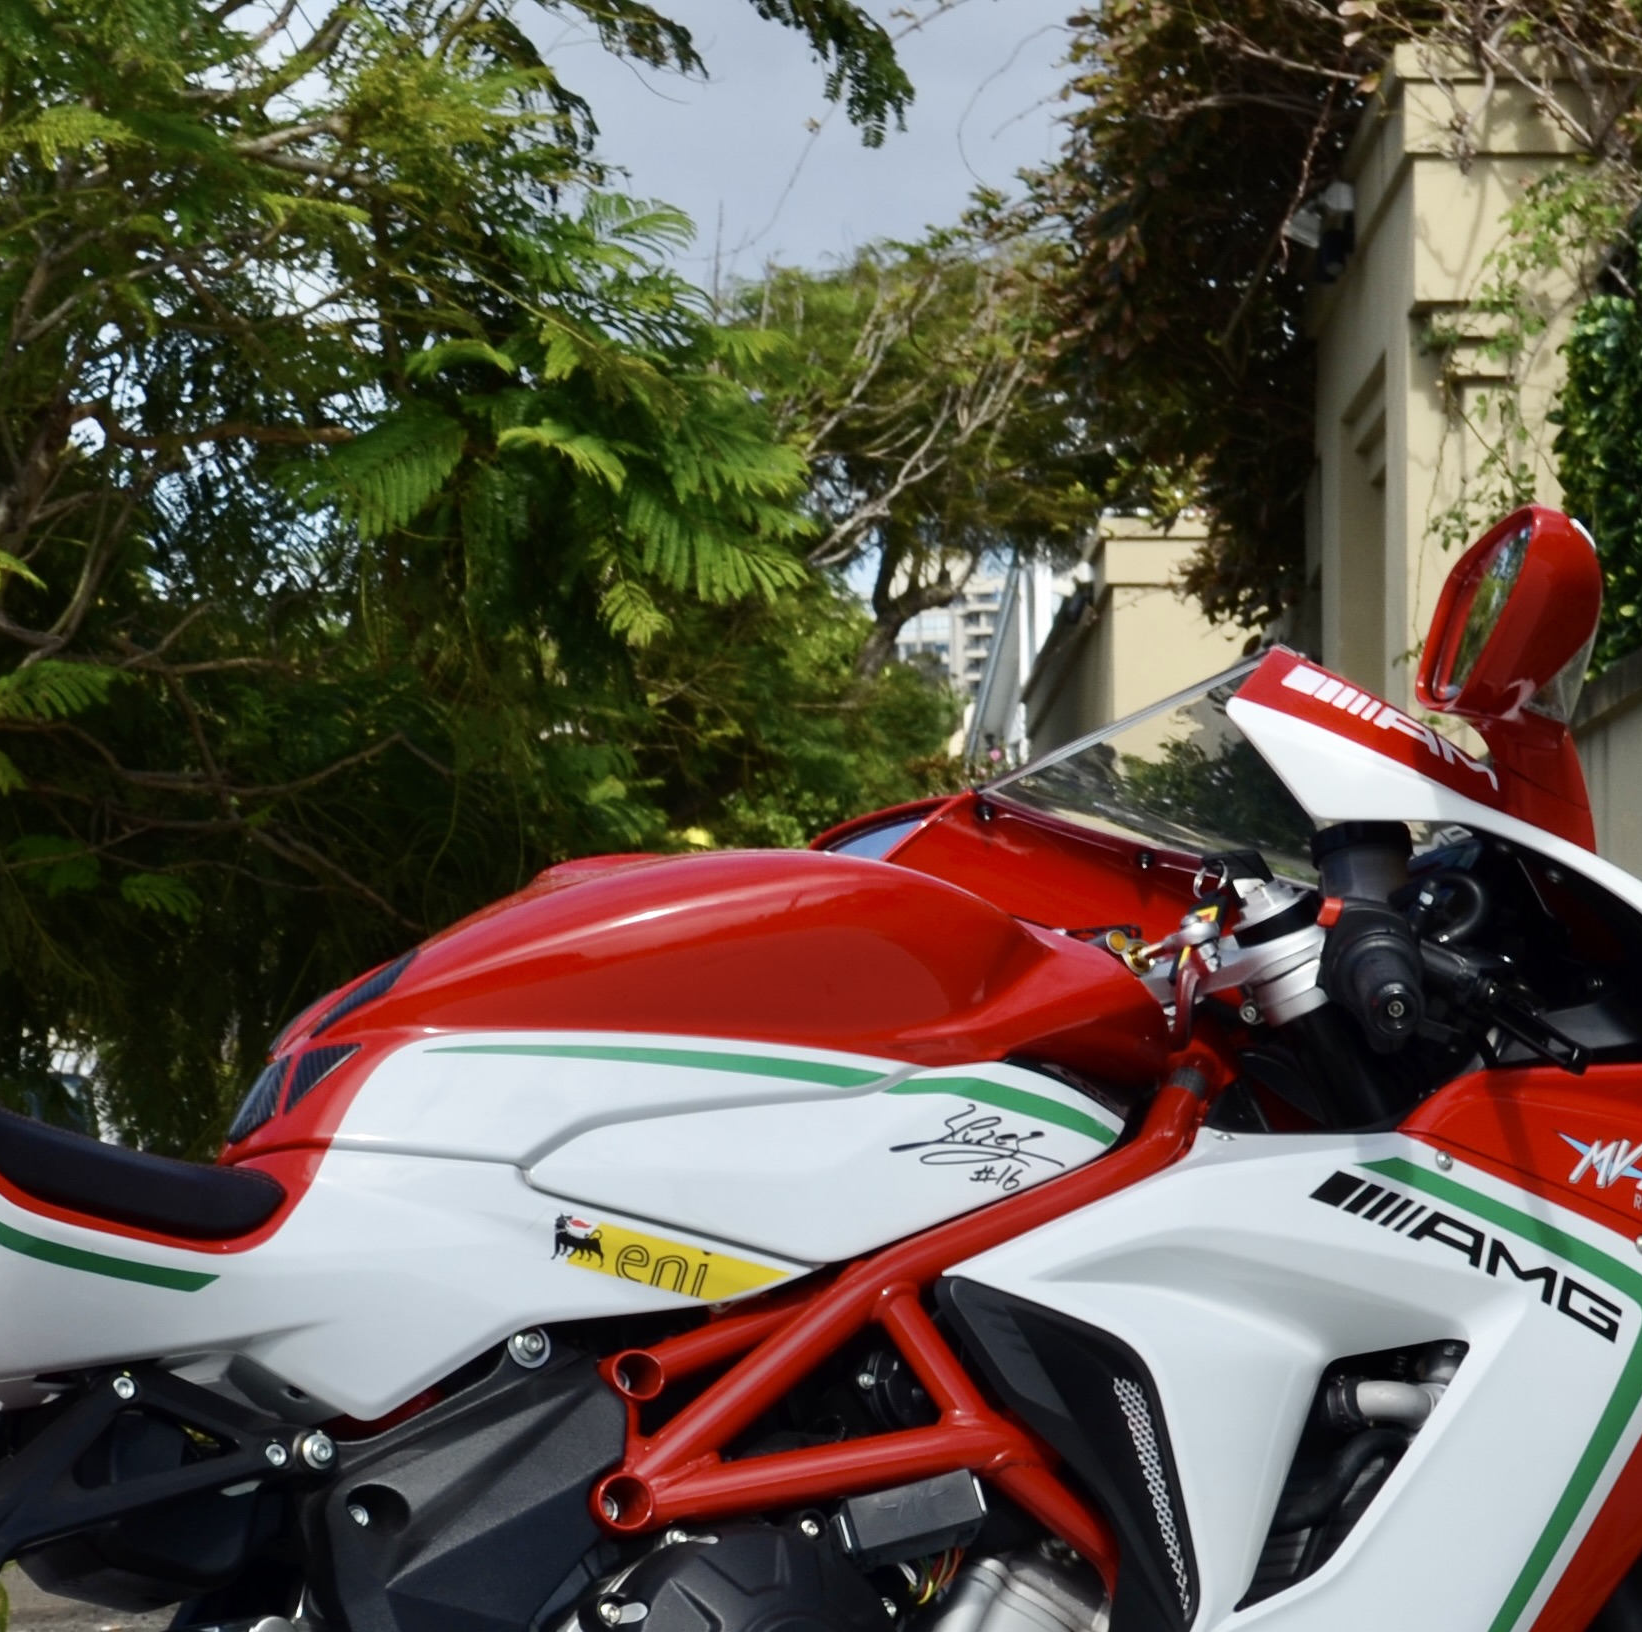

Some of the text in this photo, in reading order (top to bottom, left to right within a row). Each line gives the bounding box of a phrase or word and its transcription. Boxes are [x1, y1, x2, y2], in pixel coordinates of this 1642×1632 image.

[969, 1164, 1024, 1192] #16
[615, 1243, 713, 1298] eni
[1408, 1210, 1623, 1344] AMG
